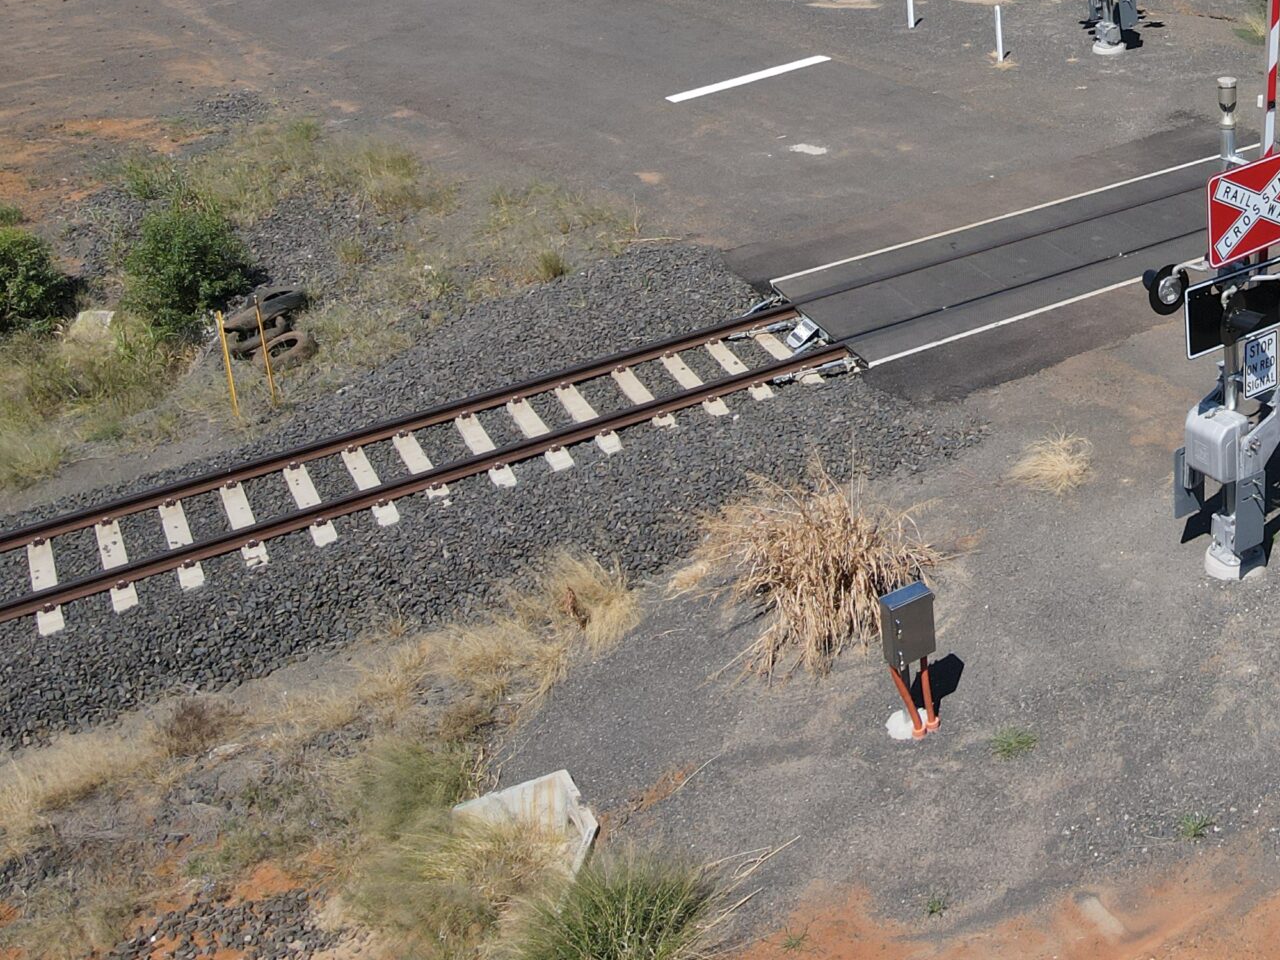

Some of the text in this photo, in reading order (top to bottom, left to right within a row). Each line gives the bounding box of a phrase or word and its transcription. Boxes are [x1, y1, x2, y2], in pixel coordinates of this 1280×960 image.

[1250, 338, 1273, 358] STOP
[1247, 355, 1275, 376] ON RED
[1247, 372, 1275, 392] SIGNAL
